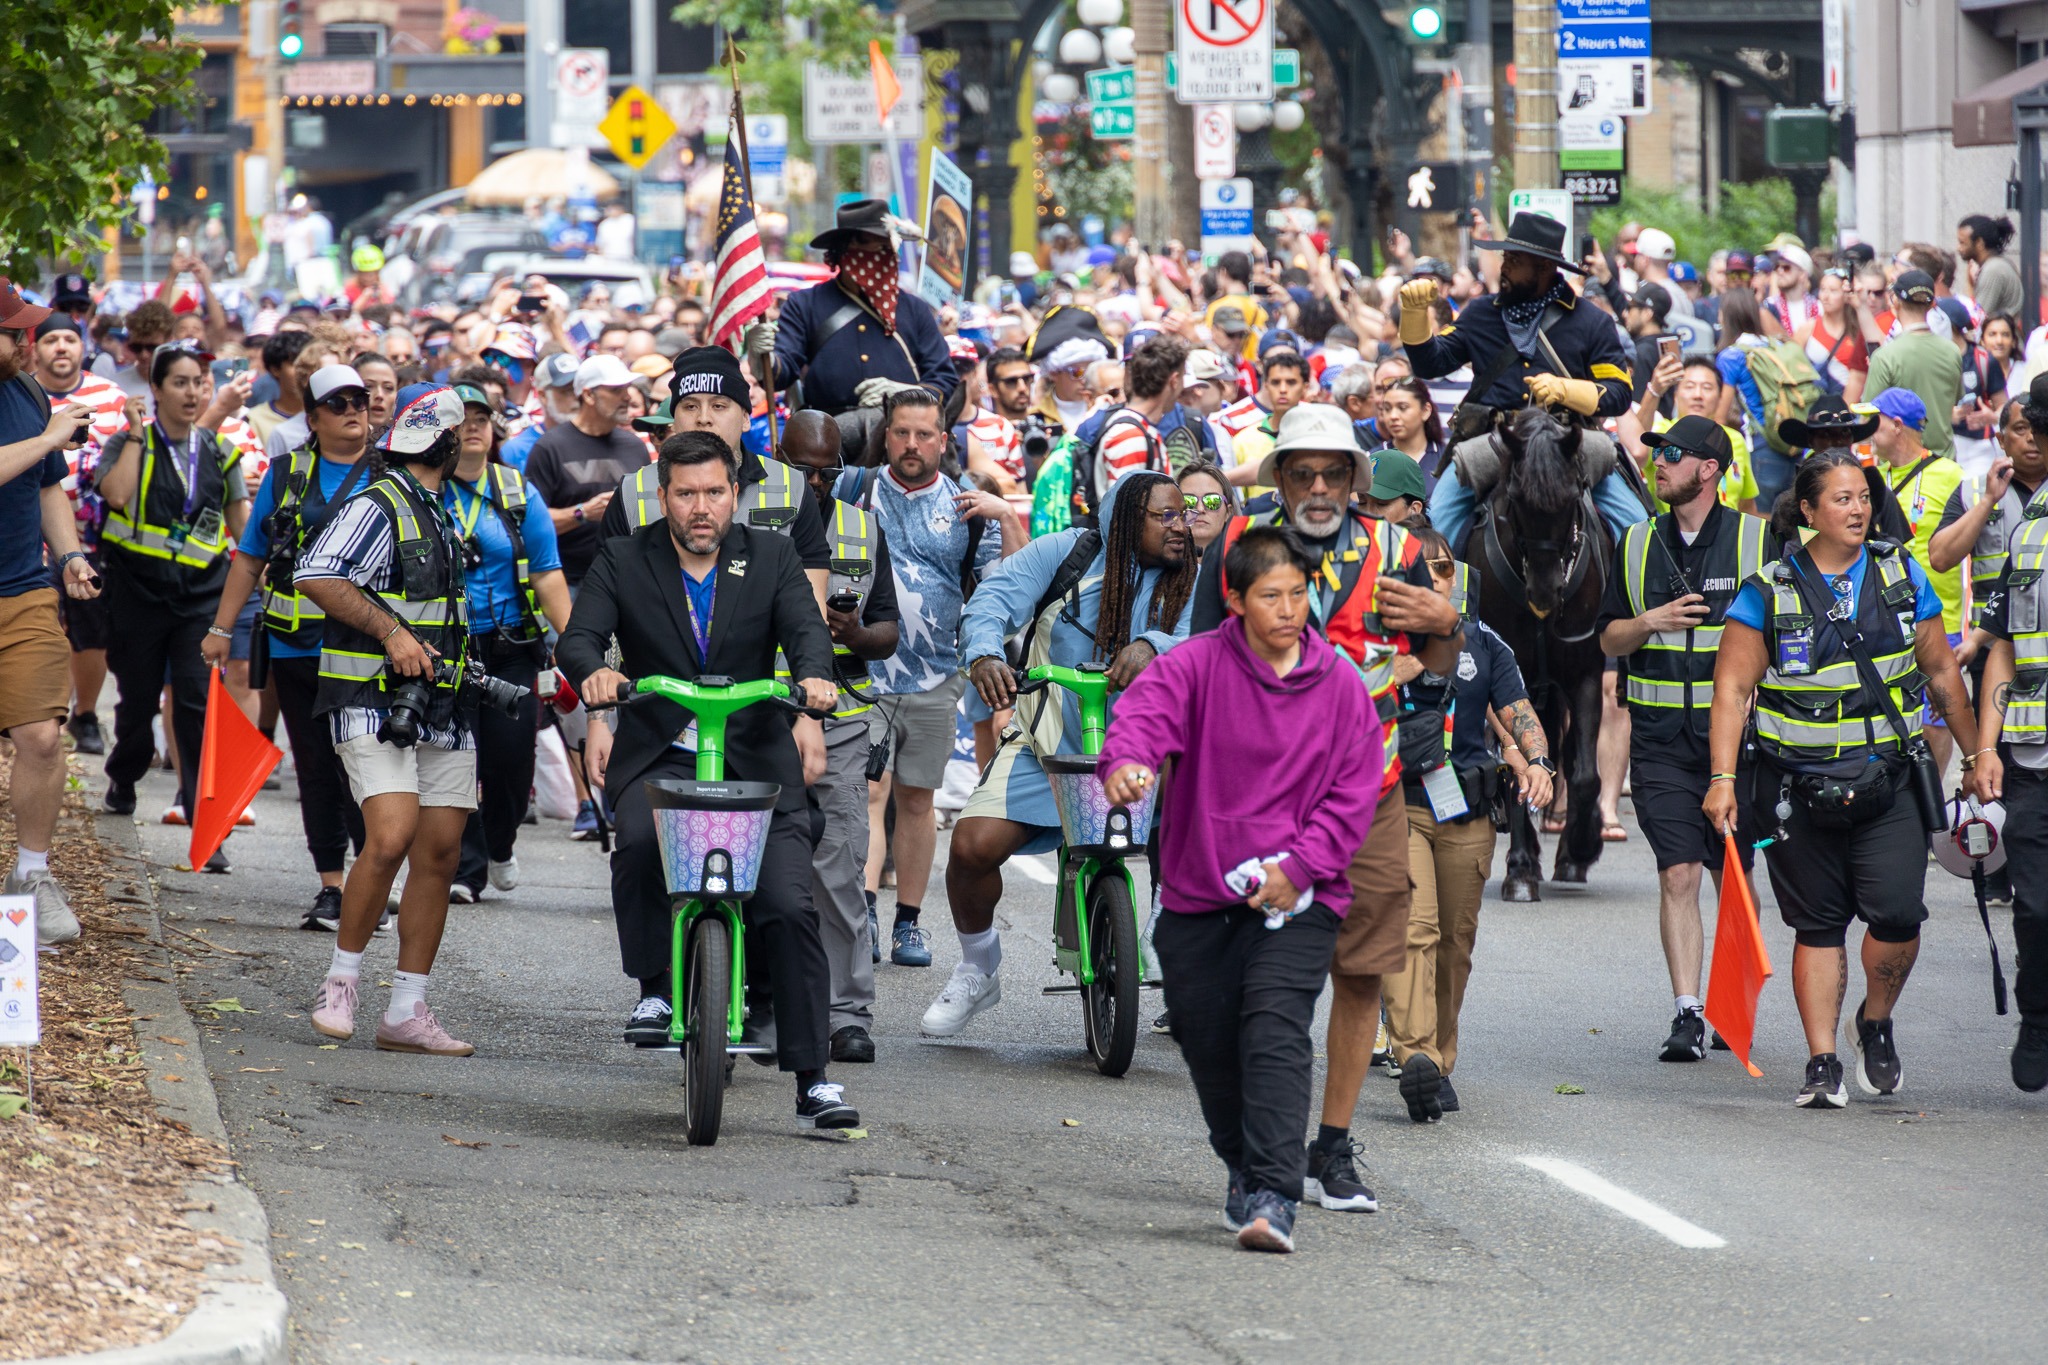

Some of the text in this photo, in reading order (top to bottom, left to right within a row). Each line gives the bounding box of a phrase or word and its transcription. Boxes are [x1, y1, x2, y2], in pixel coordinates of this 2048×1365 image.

[1562, 31, 1646, 50] 2 Hours Max
[1564, 178, 1618, 194] 86371
[679, 372, 724, 396] SECURITY
